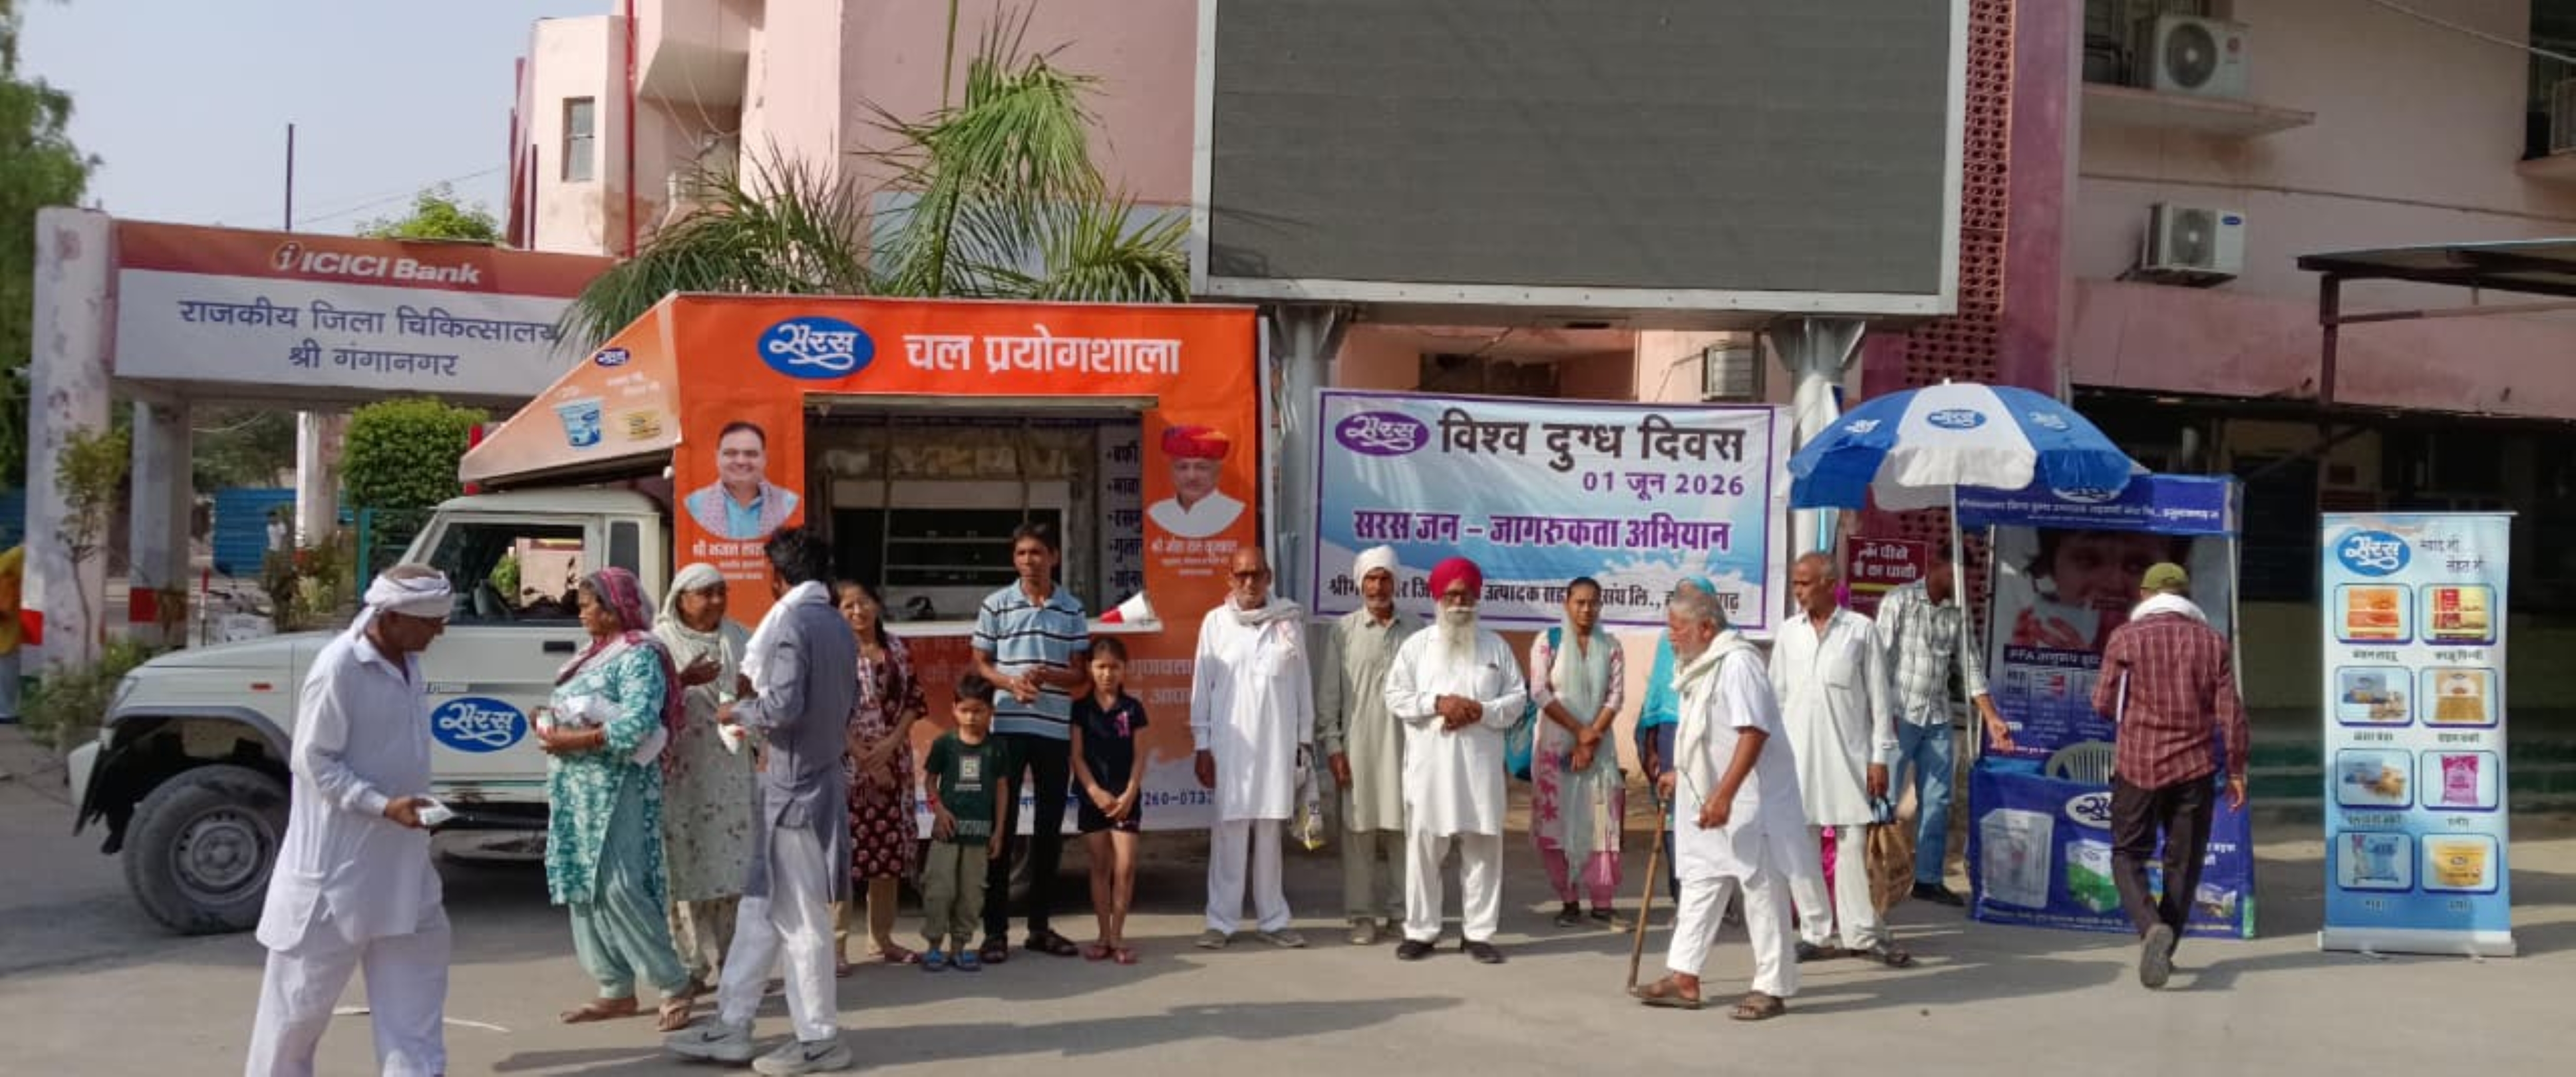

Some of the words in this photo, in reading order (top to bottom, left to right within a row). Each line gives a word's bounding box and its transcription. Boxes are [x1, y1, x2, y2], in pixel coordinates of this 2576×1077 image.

[301, 251, 388, 278] ICICI
[392, 258, 481, 284] Bank
[177, 295, 299, 328] राजकीय
[311, 299, 385, 334] जिला
[395, 305, 559, 343] चिकित्सालय
[289, 337, 321, 369] श्री
[331, 342, 459, 376] गंगानगर
[768, 323, 858, 369] सरस
[903, 333, 970, 371] चल
[984, 324, 1182, 374] प्रयोगशाला
[1344, 416, 1419, 451] सरस
[1438, 408, 1529, 455] विश्व
[1542, 422, 1625, 472] दुग्ध
[1637, 413, 1746, 462] दिवस
[1582, 471, 1614, 491] 01
[1625, 473, 1665, 501] जून
[1674, 474, 1744, 495] 2026
[1354, 511, 1412, 540] सरस
[1415, 513, 1461, 541] जन
[1625, 512, 1730, 550] अभियान
[439, 703, 517, 747] सरस
